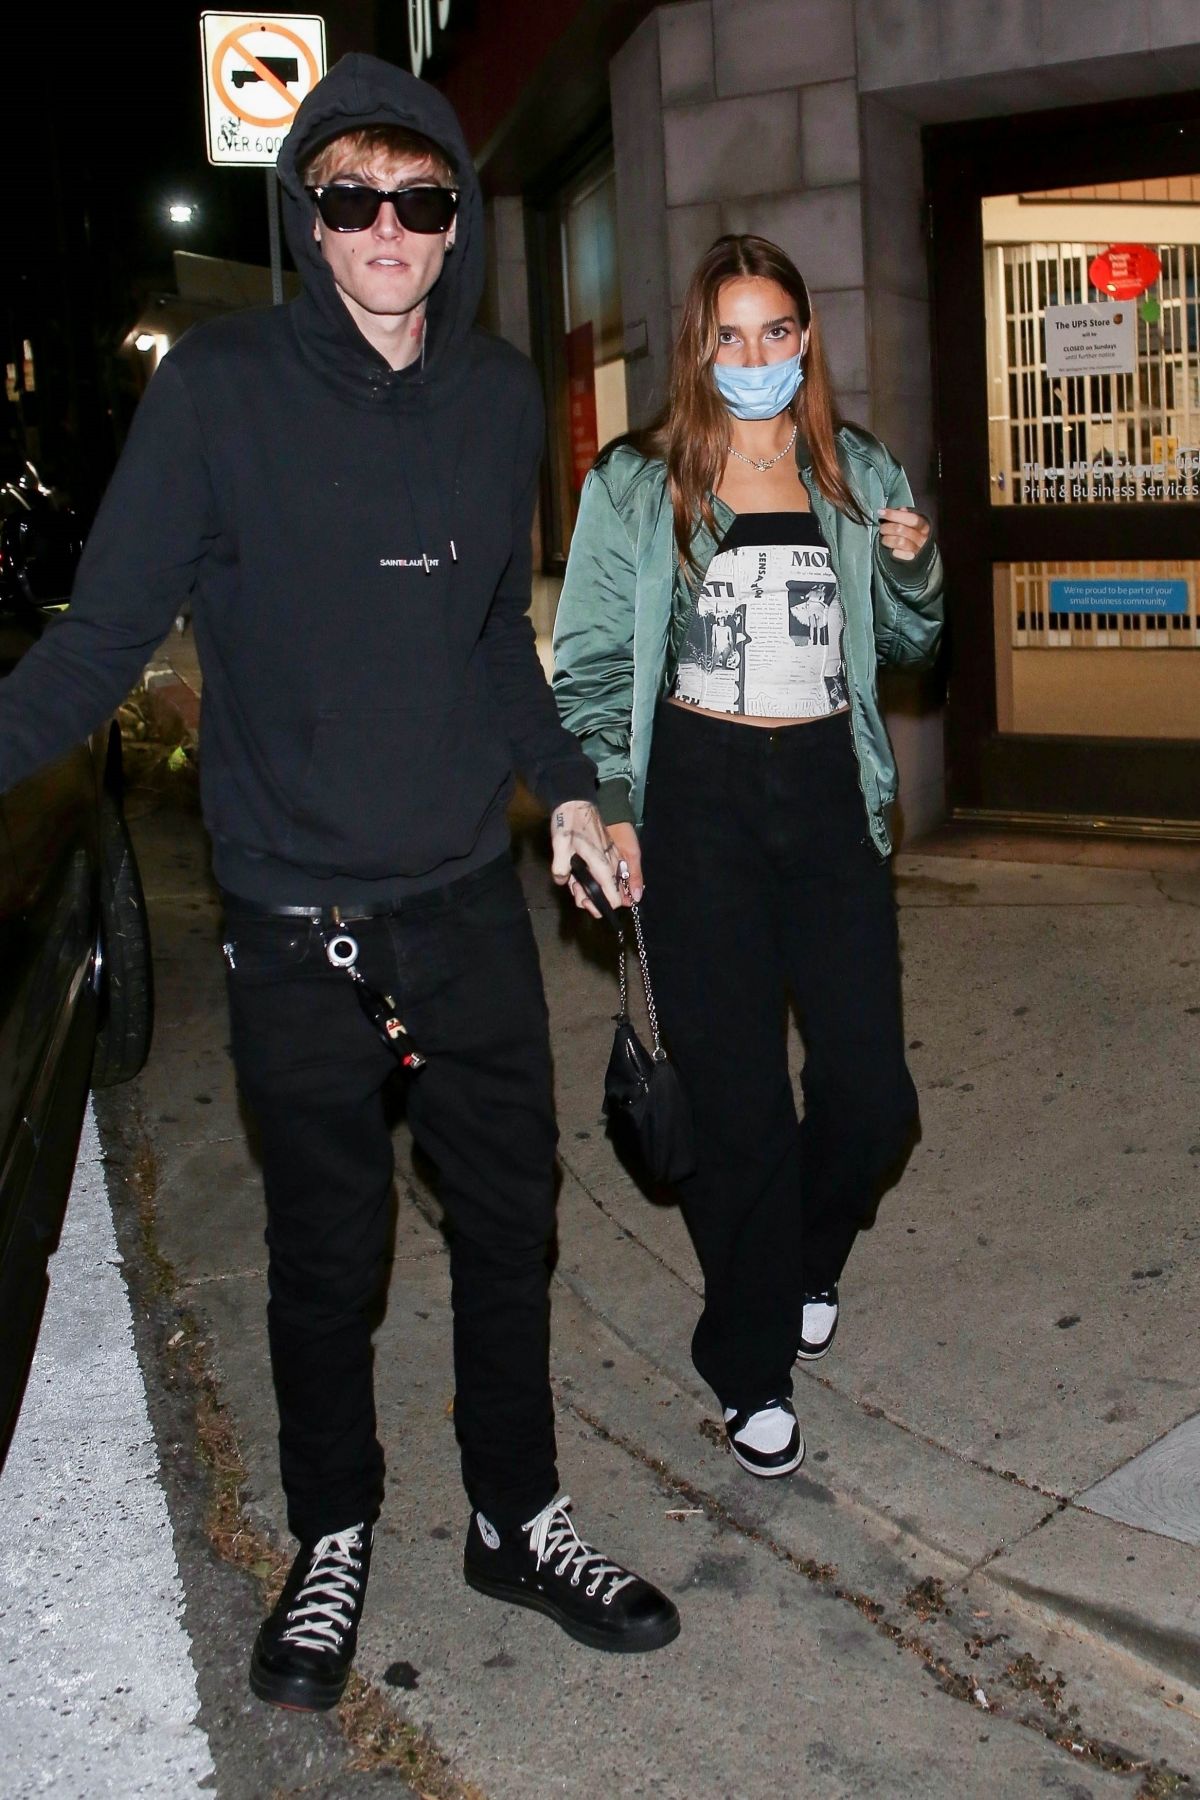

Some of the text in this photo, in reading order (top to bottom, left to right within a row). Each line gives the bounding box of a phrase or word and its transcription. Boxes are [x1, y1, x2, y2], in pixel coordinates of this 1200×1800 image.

[217, 136, 250, 151] OVER
[1055, 319, 1110, 330] The UPS Store
[1093, 343, 1117, 351] Sundays
[1023, 461, 1165, 481] The UPS Store
[1023, 482, 1199, 499] Print & Business Services
[1064, 586, 1084, 594] We're
[1085, 586, 1107, 595] proud
[1117, 586, 1127, 594] be
[1128, 587, 1144, 595] part
[1145, 586, 1155, 594] of
[1090, 597, 1122, 605] business
[1123, 597, 1167, 607] community.
